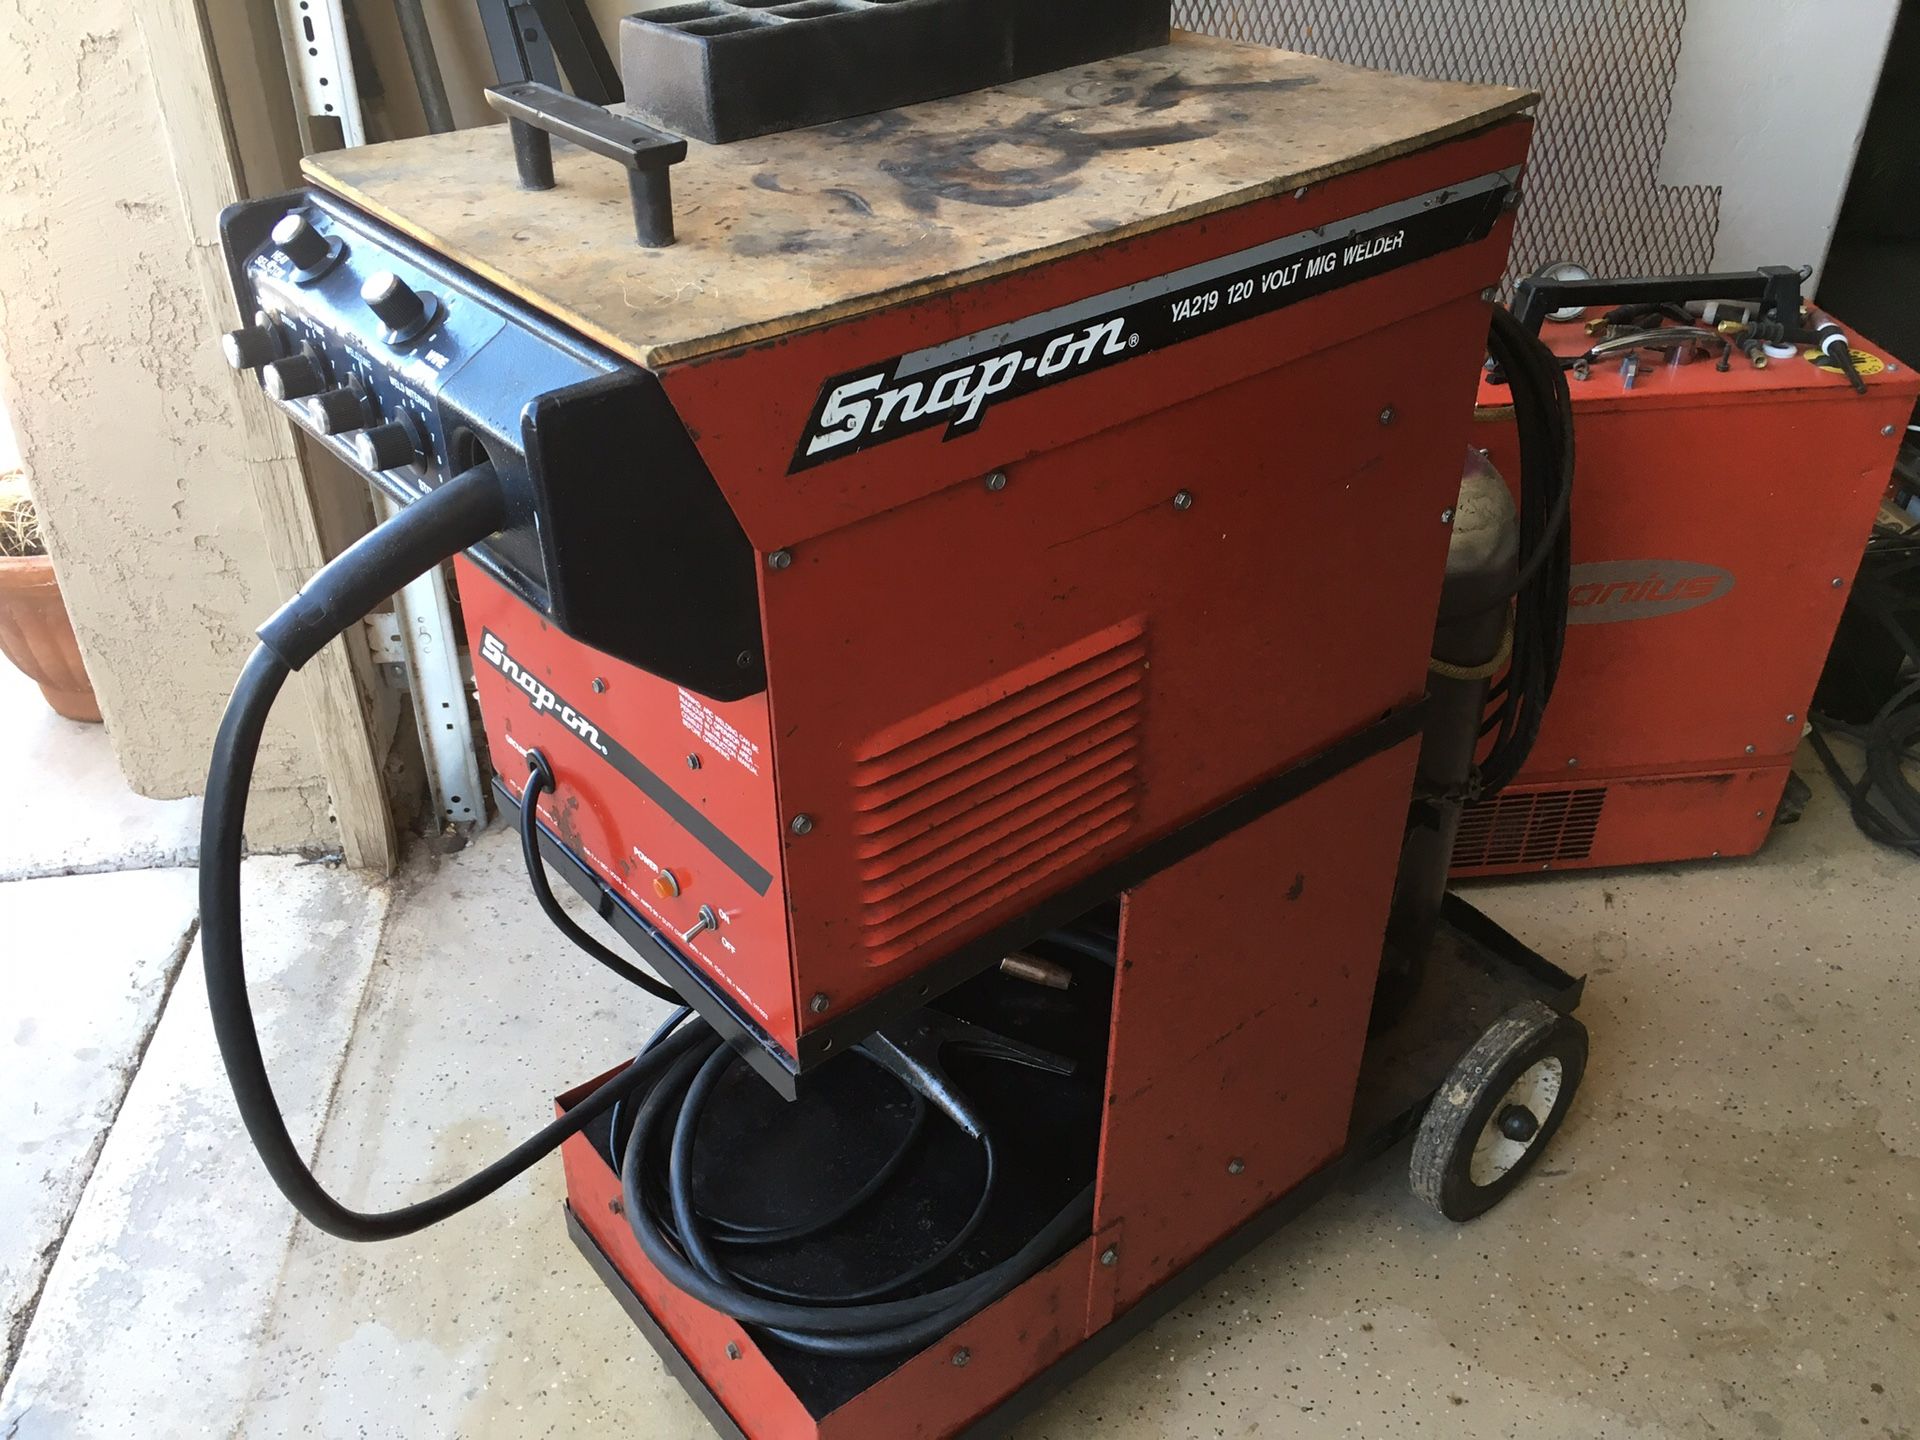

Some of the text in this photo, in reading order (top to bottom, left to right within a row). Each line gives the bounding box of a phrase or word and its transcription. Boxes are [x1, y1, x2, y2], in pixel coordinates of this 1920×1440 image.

[1171, 230, 1404, 322] YA219 120 VOLT MIG WELDER
[806, 317, 1128, 456] Snap-on
[1567, 572, 1723, 607] onius
[482, 633, 602, 750] Snap-on
[633, 846, 659, 874] POWER
[719, 908, 730, 925] ON
[721, 936, 736, 954] OFF
